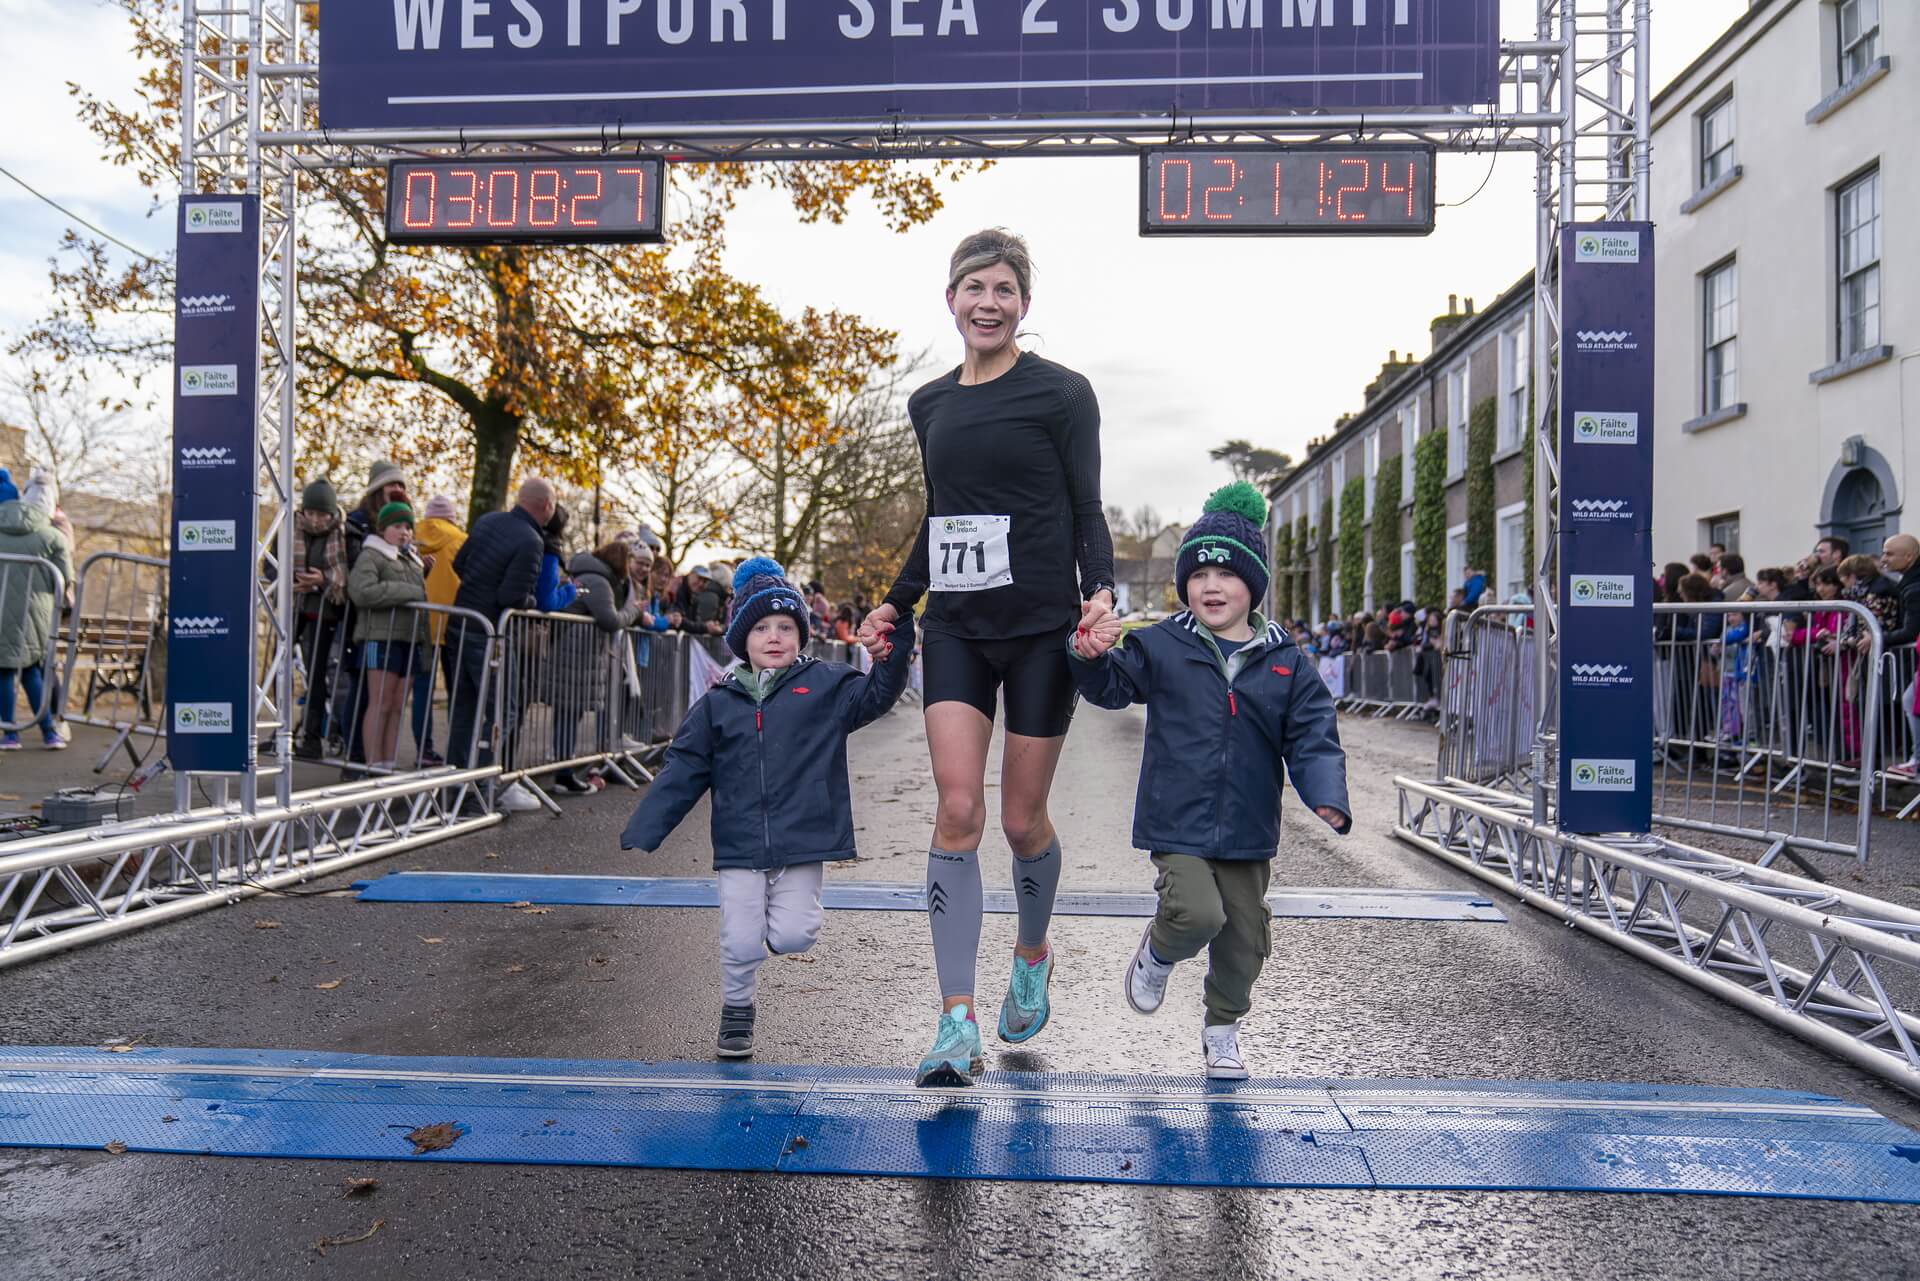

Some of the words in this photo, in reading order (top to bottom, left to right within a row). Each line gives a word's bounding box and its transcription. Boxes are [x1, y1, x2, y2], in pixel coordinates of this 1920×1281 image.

[1160, 160, 1414, 220] 02:11:24
[404, 169, 644, 228] 03:08:27
[209, 218, 240, 227] Ireland
[1601, 237, 1629, 248] Fáilte
[1601, 247, 1637, 257] Ireland
[204, 370, 229, 381] Fáilte
[204, 380, 235, 389] Ireland
[1600, 418, 1628, 428] Fáilte
[1600, 428, 1635, 437] Ireland
[201, 526, 226, 536] Fáilte
[201, 535, 233, 544] Ireland
[940, 541, 986, 574] 771
[1596, 581, 1624, 591] Fáilte
[1596, 590, 1632, 600] Ireland
[198, 709, 223, 718] Fáilte
[198, 718, 230, 727] Ireland
[1597, 765, 1625, 775] Fáilte
[1597, 775, 1633, 785] Ireland
